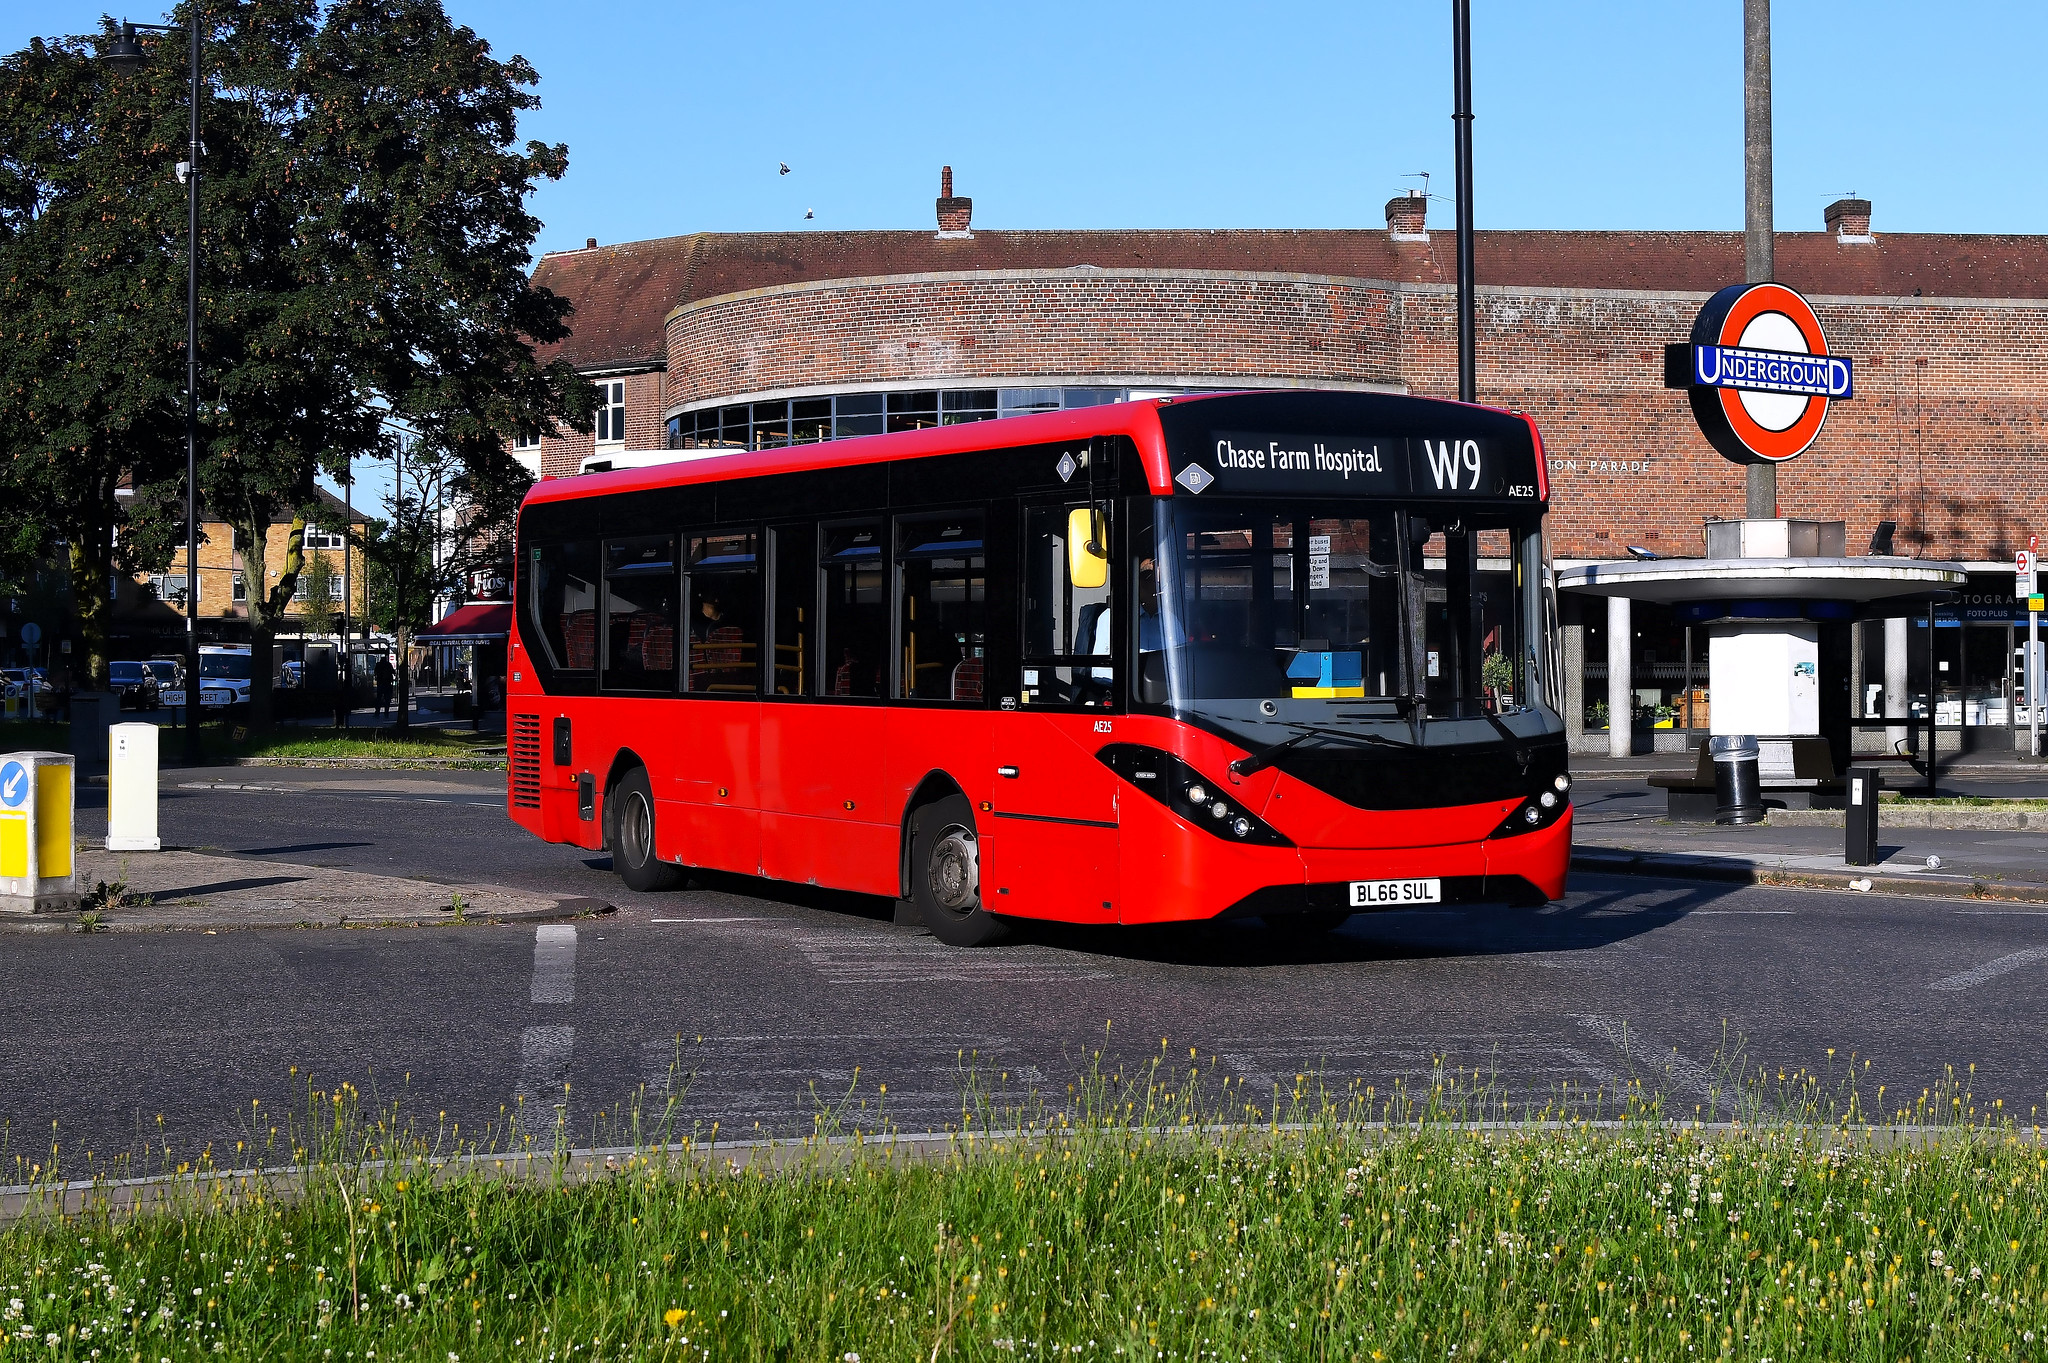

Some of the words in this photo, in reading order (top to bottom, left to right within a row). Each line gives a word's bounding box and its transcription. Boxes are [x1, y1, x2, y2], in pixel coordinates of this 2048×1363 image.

[1698, 346, 1849, 395] UNDERGROUND
[1216, 439, 1266, 469] Chase
[1269, 441, 1310, 470] Farm
[1314, 443, 1383, 480] Hospital
[1423, 439, 1481, 491] W9
[1548, 460, 1577, 470] ION
[1590, 460, 1650, 472] PARADE
[1507, 485, 1534, 497] AE25
[2030, 536, 2036, 547] F
[165, 694, 184, 702] HIGH
[200, 693, 218, 702] REET
[1093, 721, 1112, 733] AE25
[1356, 884, 1398, 903] BL66
[1403, 882, 1434, 900] SUL
